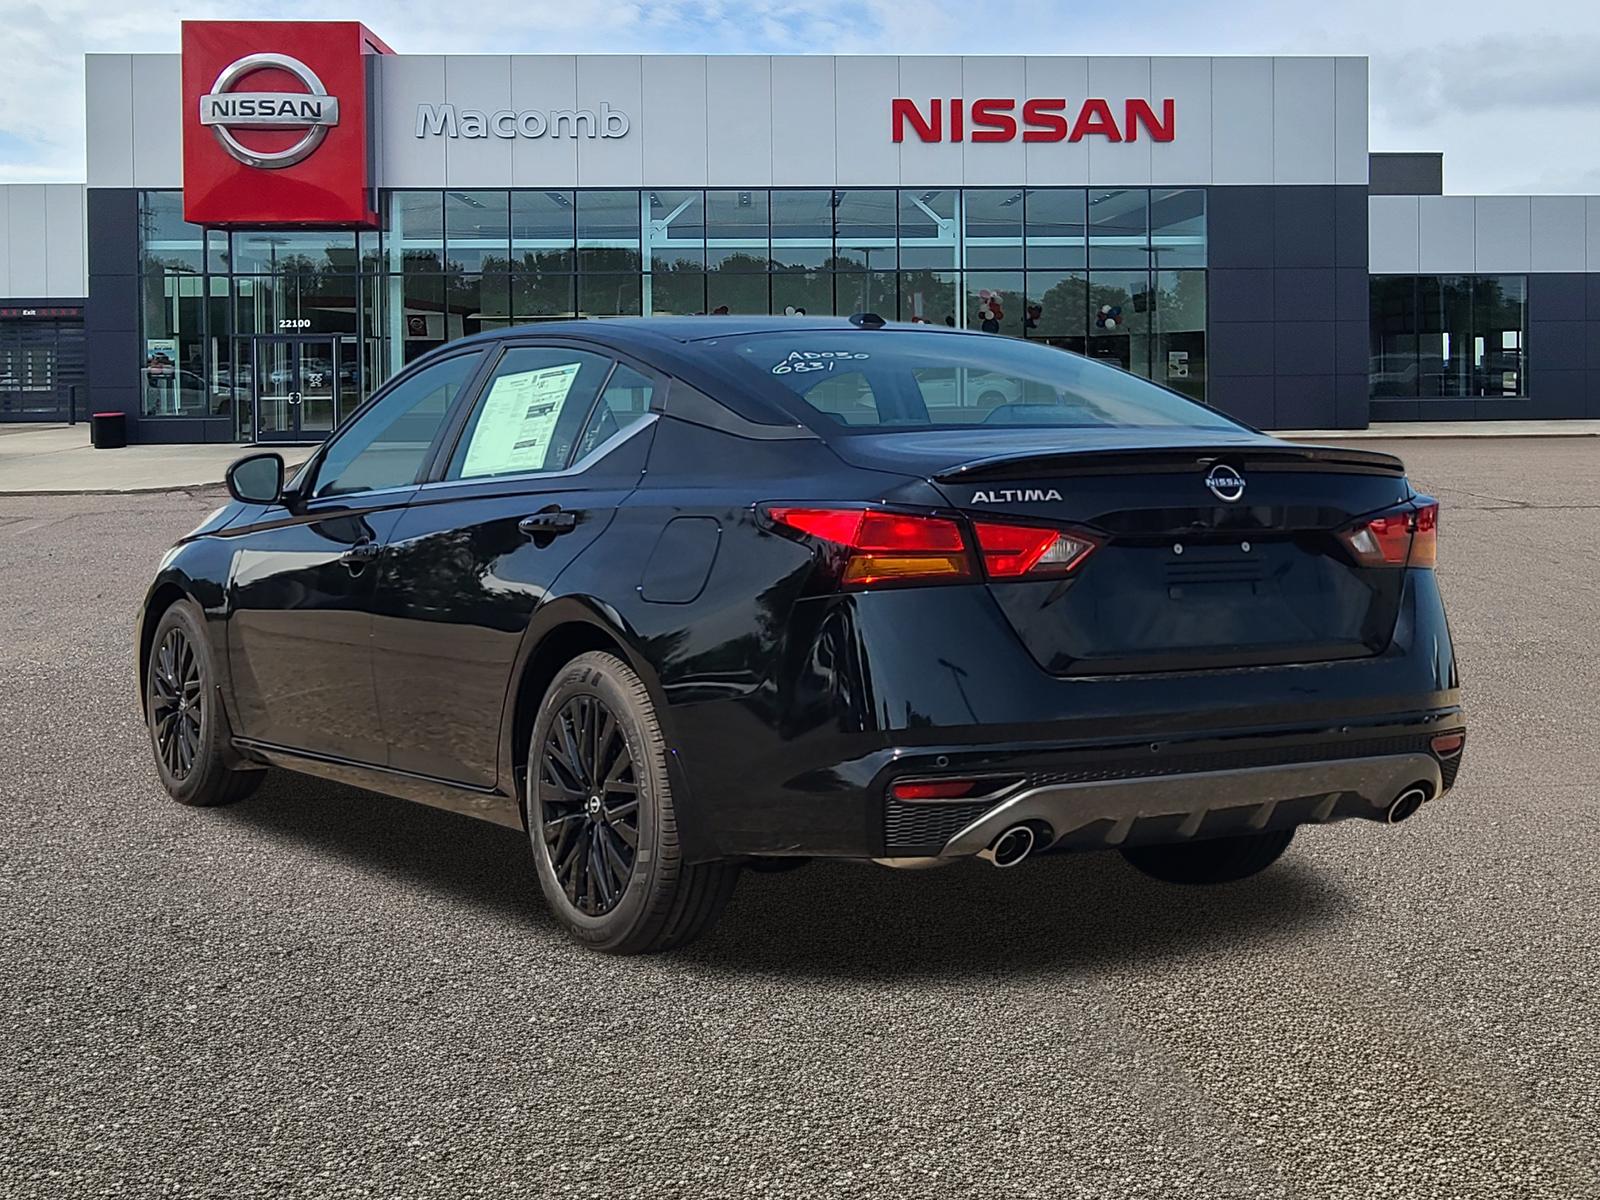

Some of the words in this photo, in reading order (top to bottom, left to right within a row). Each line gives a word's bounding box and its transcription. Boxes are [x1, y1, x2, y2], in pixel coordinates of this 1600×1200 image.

[211, 98, 323, 119] NISSAN
[415, 102, 630, 139] Macomb
[892, 98, 1176, 143] NISSAN
[279, 319, 311, 328] 22100
[1204, 477, 1246, 488] NISSAN
[970, 488, 1063, 504] ALTIMA
